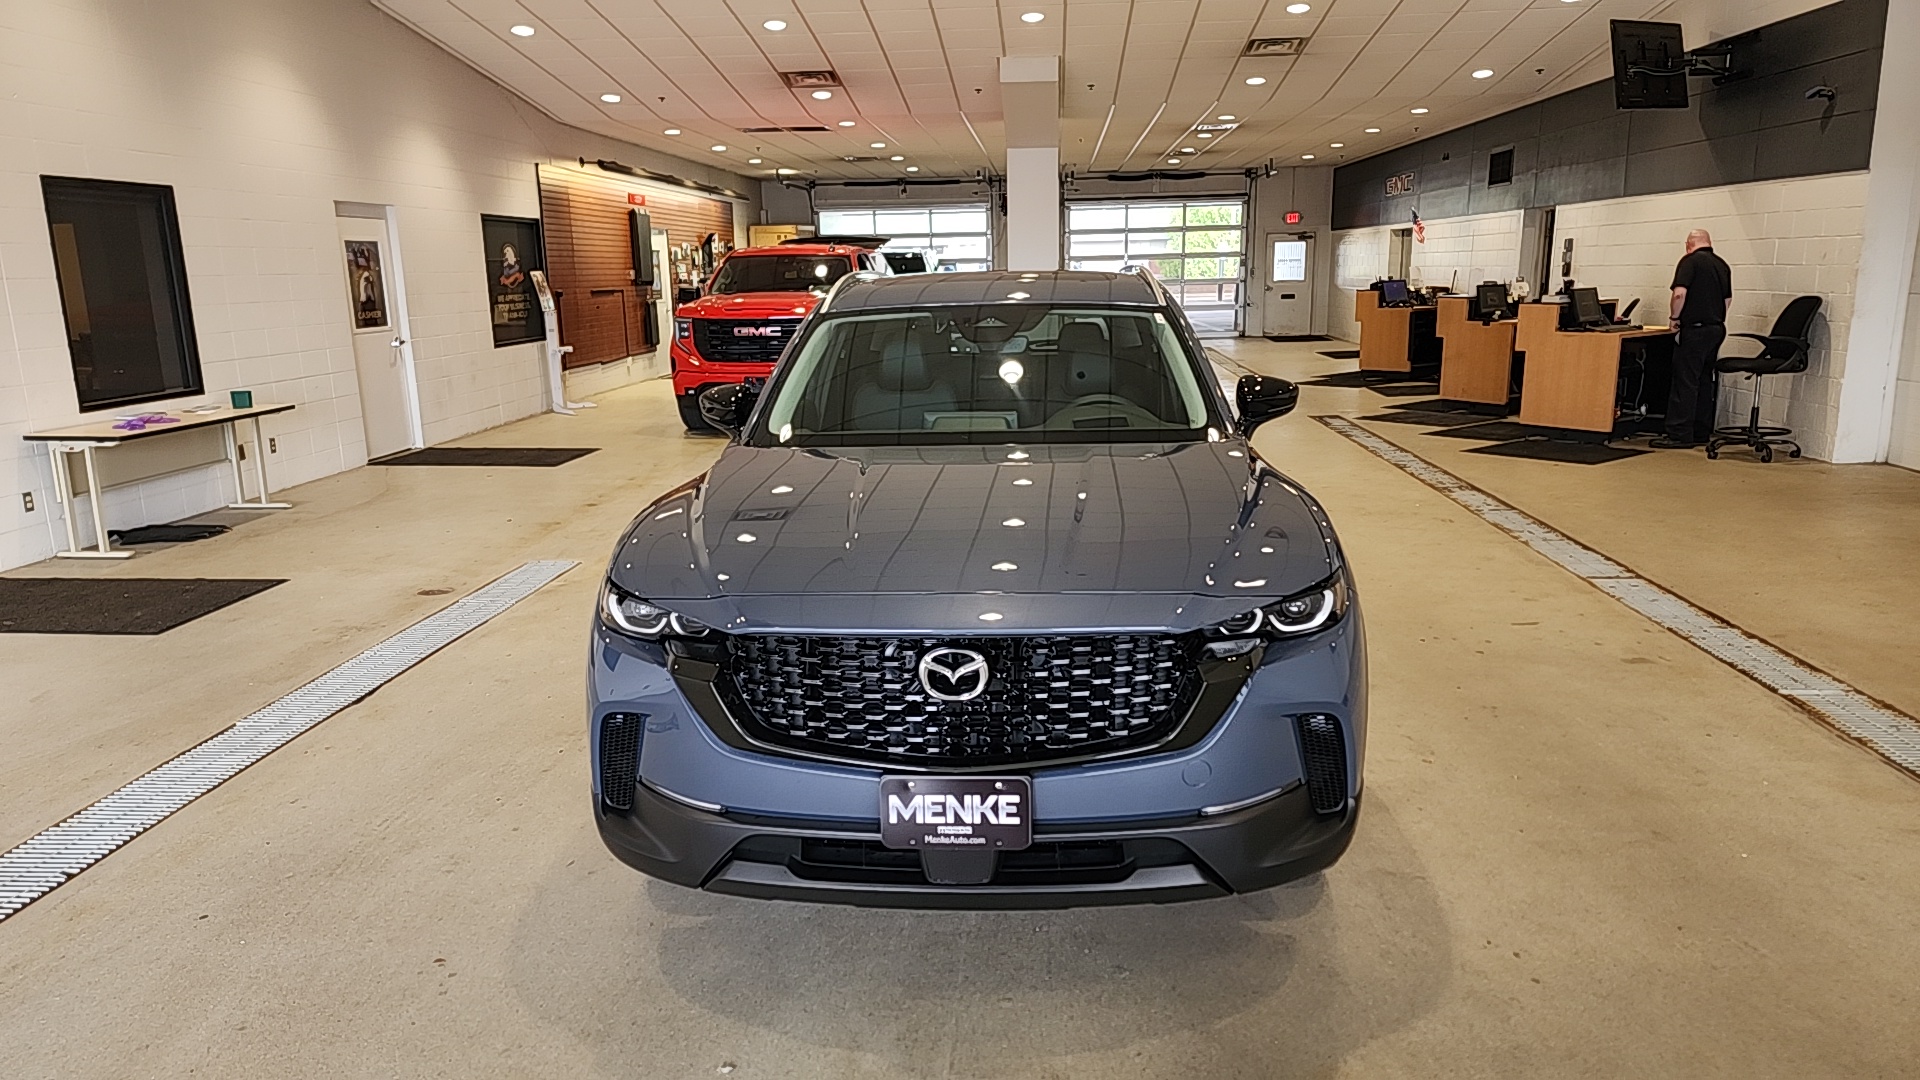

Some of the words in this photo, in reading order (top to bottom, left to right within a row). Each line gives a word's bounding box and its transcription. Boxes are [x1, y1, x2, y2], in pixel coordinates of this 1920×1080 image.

[1385, 172, 1415, 197] GMC
[1286, 212, 1299, 224] EXIT
[357, 310, 382, 320] CASHIER
[733, 326, 782, 337] GMC
[888, 794, 1021, 825] MENKE
[924, 834, 986, 845] MenkeAuto.com
